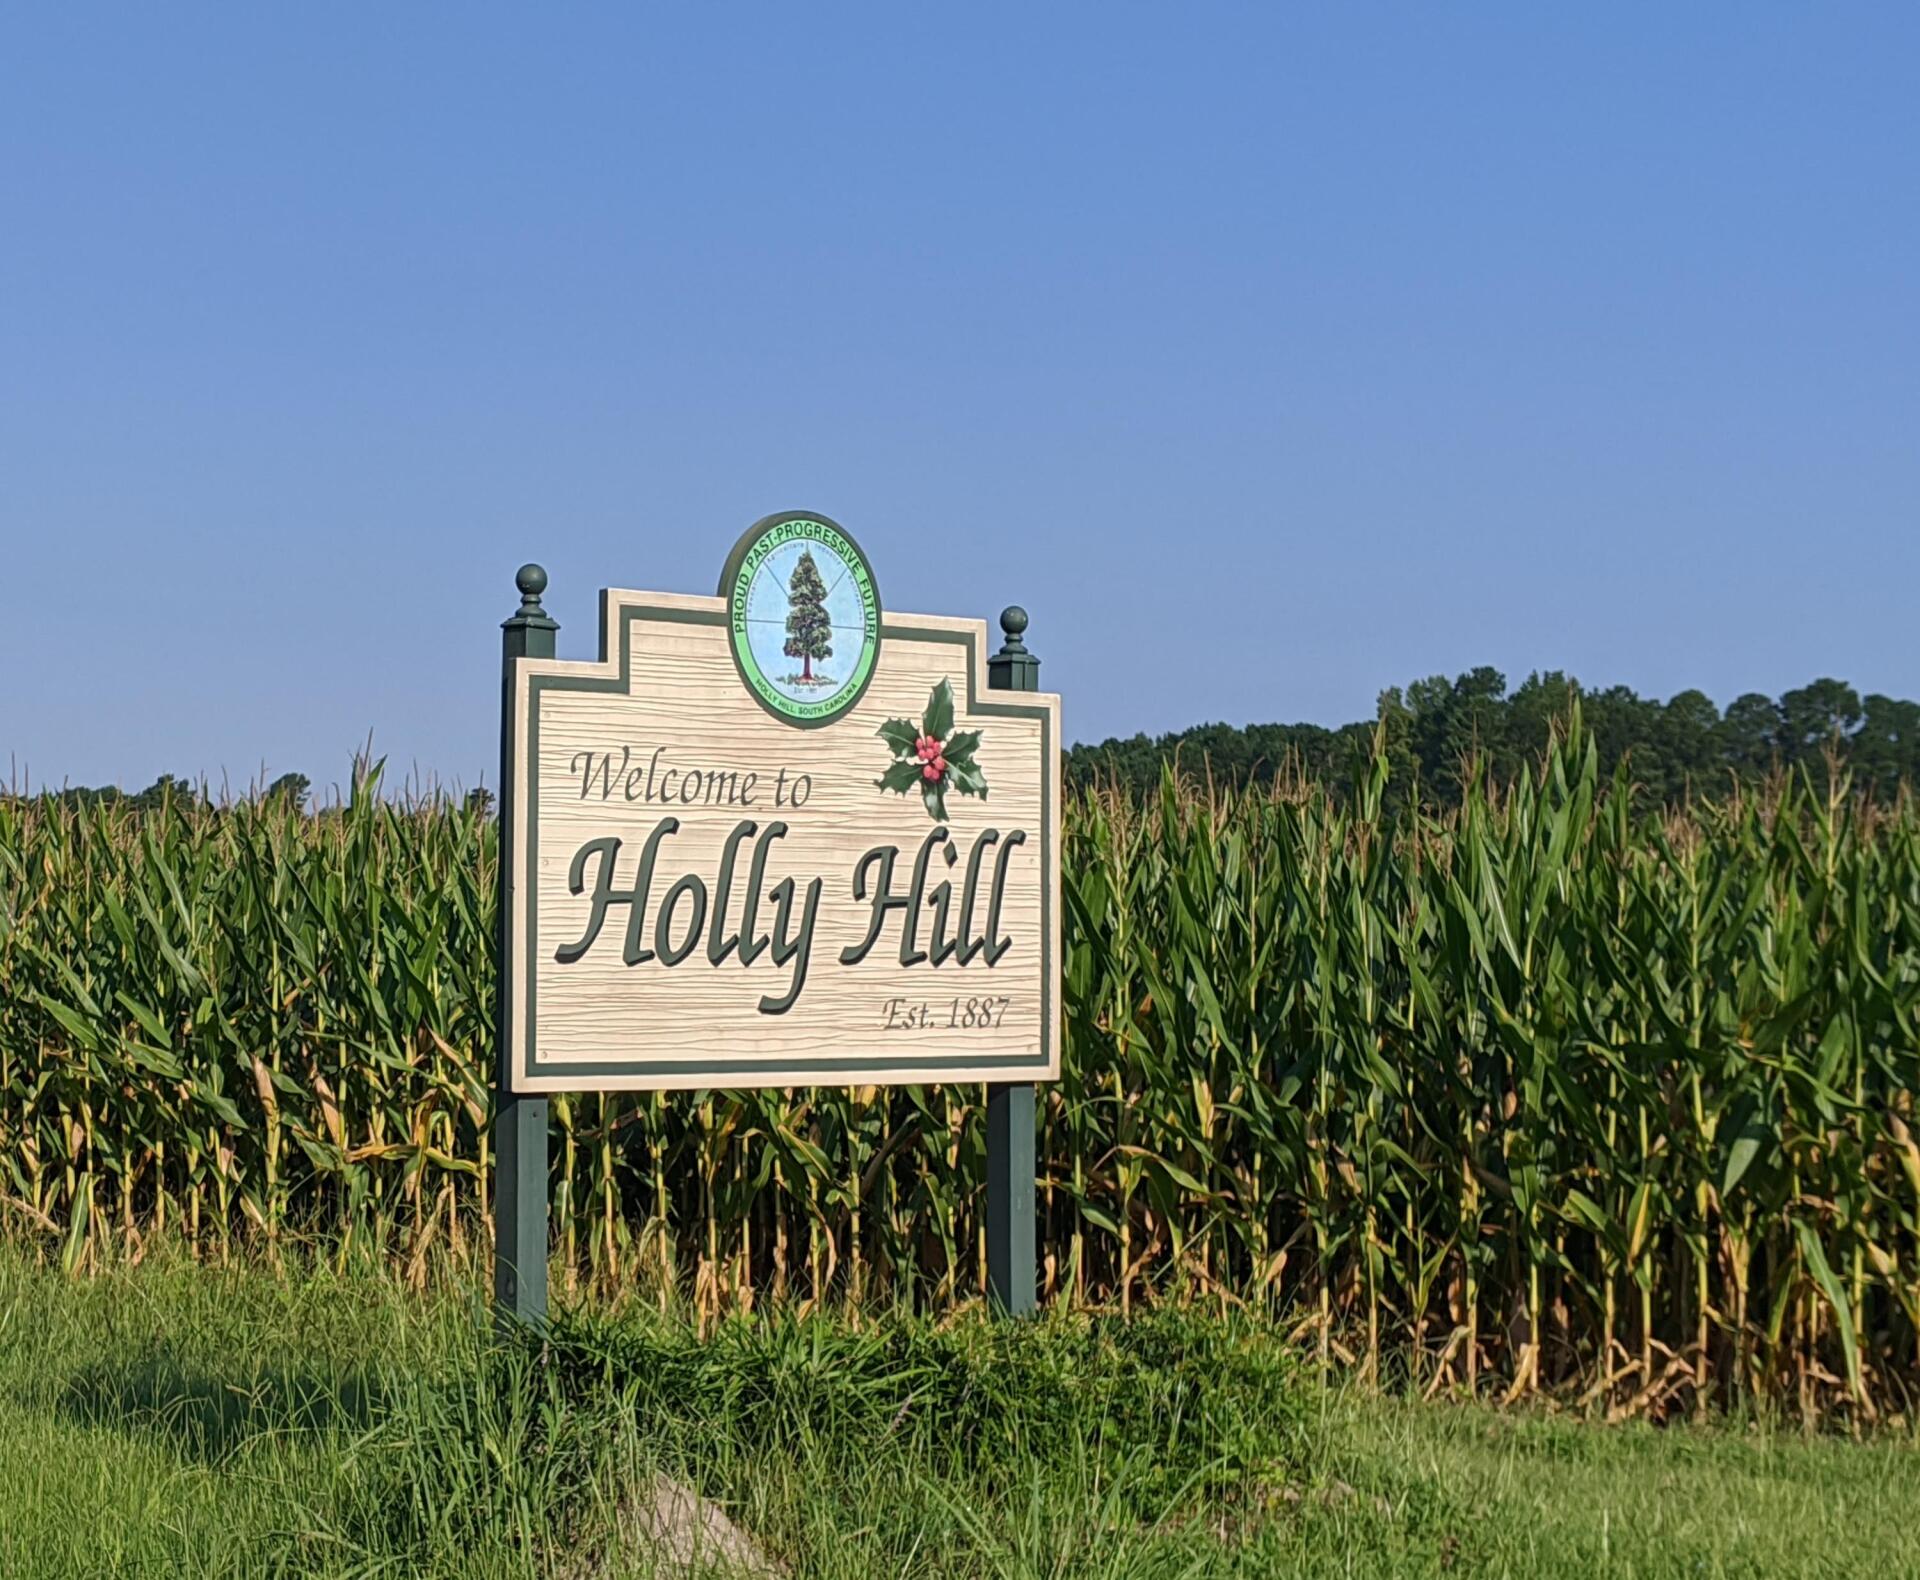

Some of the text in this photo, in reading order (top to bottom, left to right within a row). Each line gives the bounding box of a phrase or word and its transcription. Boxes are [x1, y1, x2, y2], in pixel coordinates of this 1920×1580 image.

[734, 574, 750, 633] PROUD
[860, 578, 876, 644] FUTURE
[755, 679, 779, 703] HOLLY
[798, 706, 823, 715] SOUTH
[824, 683, 857, 710] CAROLINA
[570, 745, 812, 808] Welcome to
[554, 816, 1027, 1015] Holly Hill
[882, 997, 1011, 1030] Est. 1887
